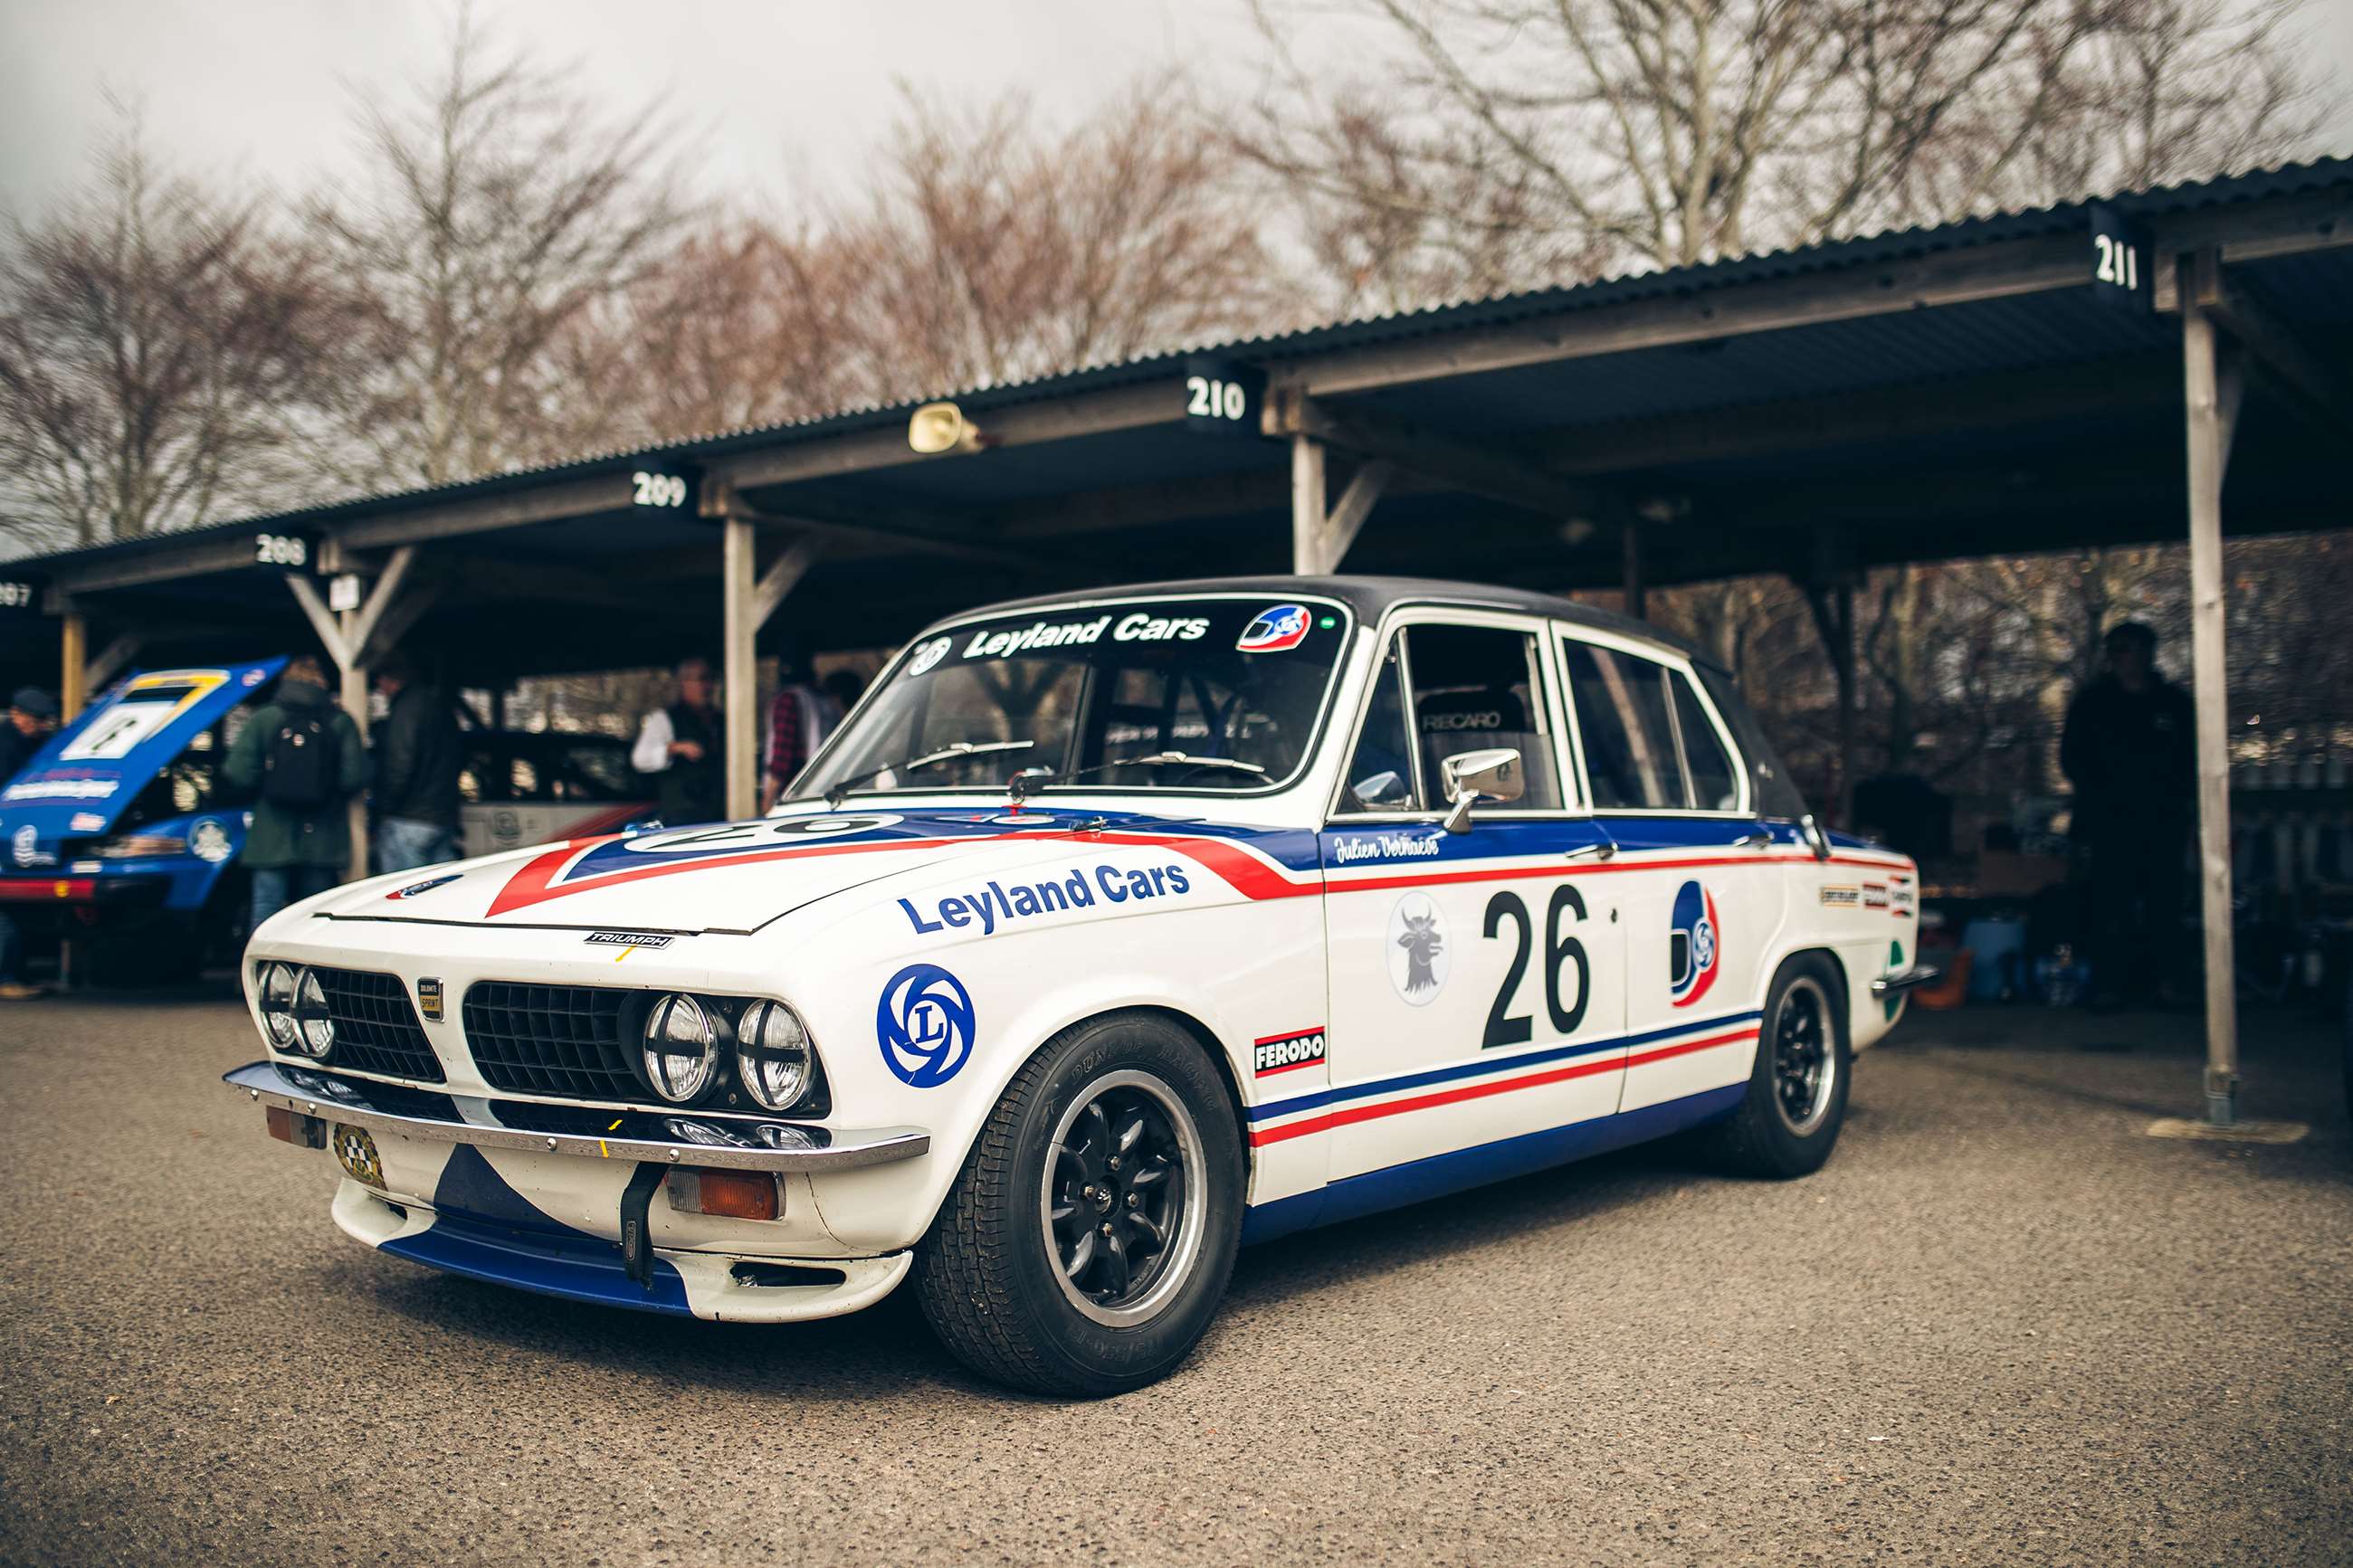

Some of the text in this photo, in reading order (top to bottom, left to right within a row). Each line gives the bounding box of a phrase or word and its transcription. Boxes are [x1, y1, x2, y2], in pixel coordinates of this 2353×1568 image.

[2094, 234, 2137, 290] 211
[1186, 375, 1245, 421] 210
[633, 471, 686, 507] 209
[0, 582, 31, 606] 07
[964, 615, 1111, 659] Leyland
[1114, 613, 1209, 641] Cars
[1423, 710, 1500, 729] RECARO
[1334, 836, 1380, 864] Julien
[897, 864, 1190, 936] Leyland Cars
[591, 933, 668, 946] TRIUMPH
[1481, 883, 1590, 1050] 26
[915, 1005, 944, 1043] L
[1255, 1034, 1325, 1070] FERODO
